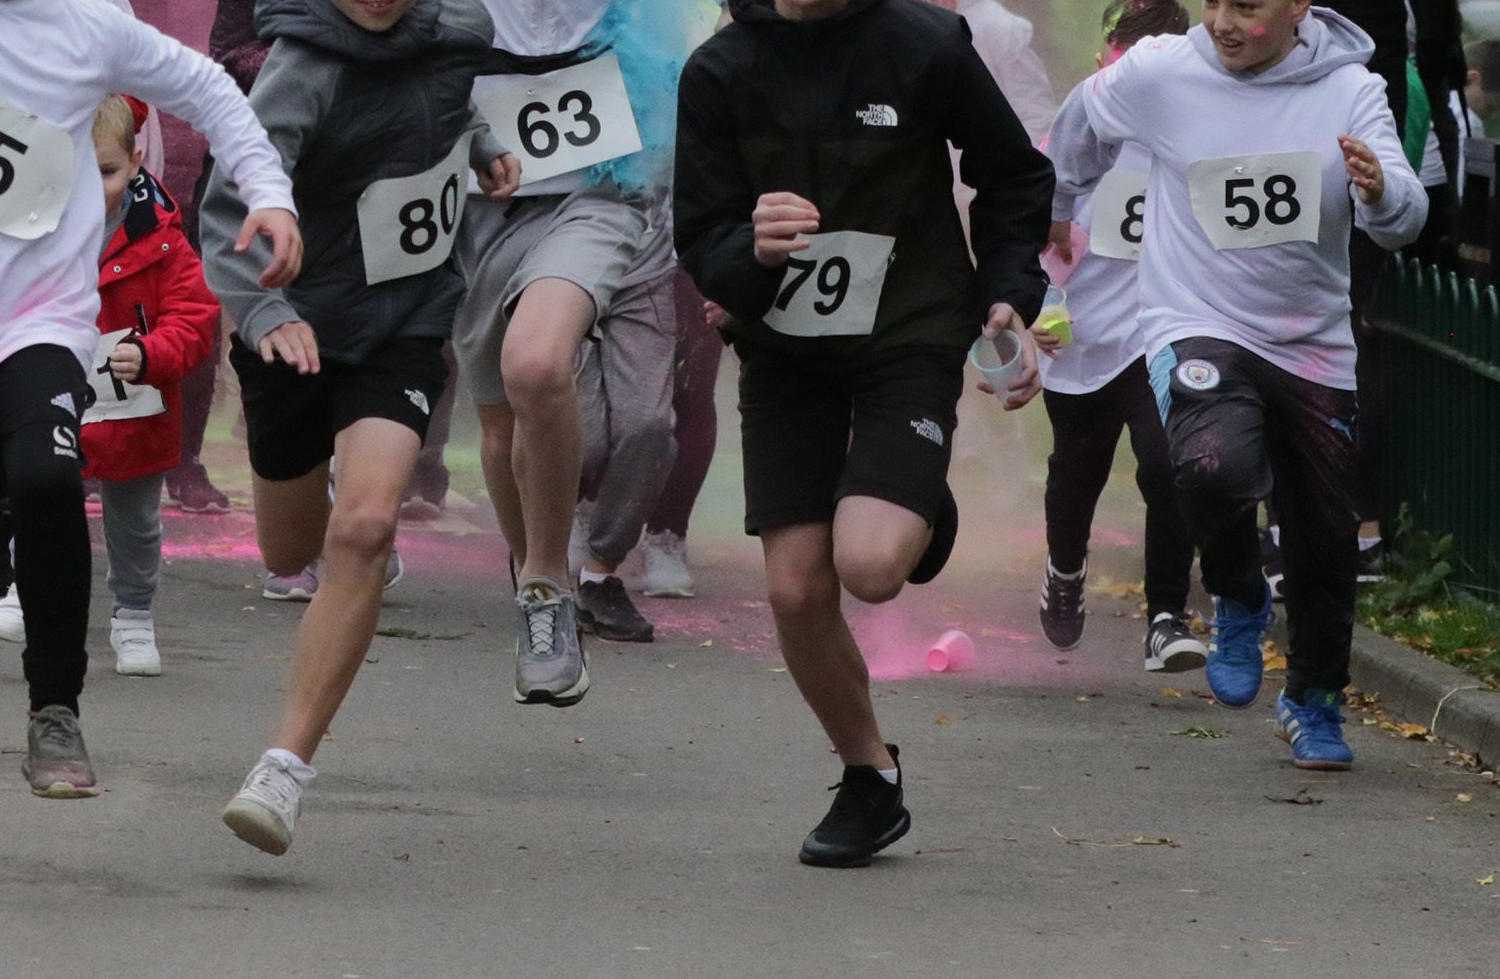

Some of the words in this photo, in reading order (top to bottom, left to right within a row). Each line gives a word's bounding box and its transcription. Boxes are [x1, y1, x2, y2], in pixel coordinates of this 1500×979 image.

[517, 89, 601, 159] 63
[398, 173, 458, 255] 80
[1224, 174, 1301, 230] 58
[774, 255, 851, 316] 79
